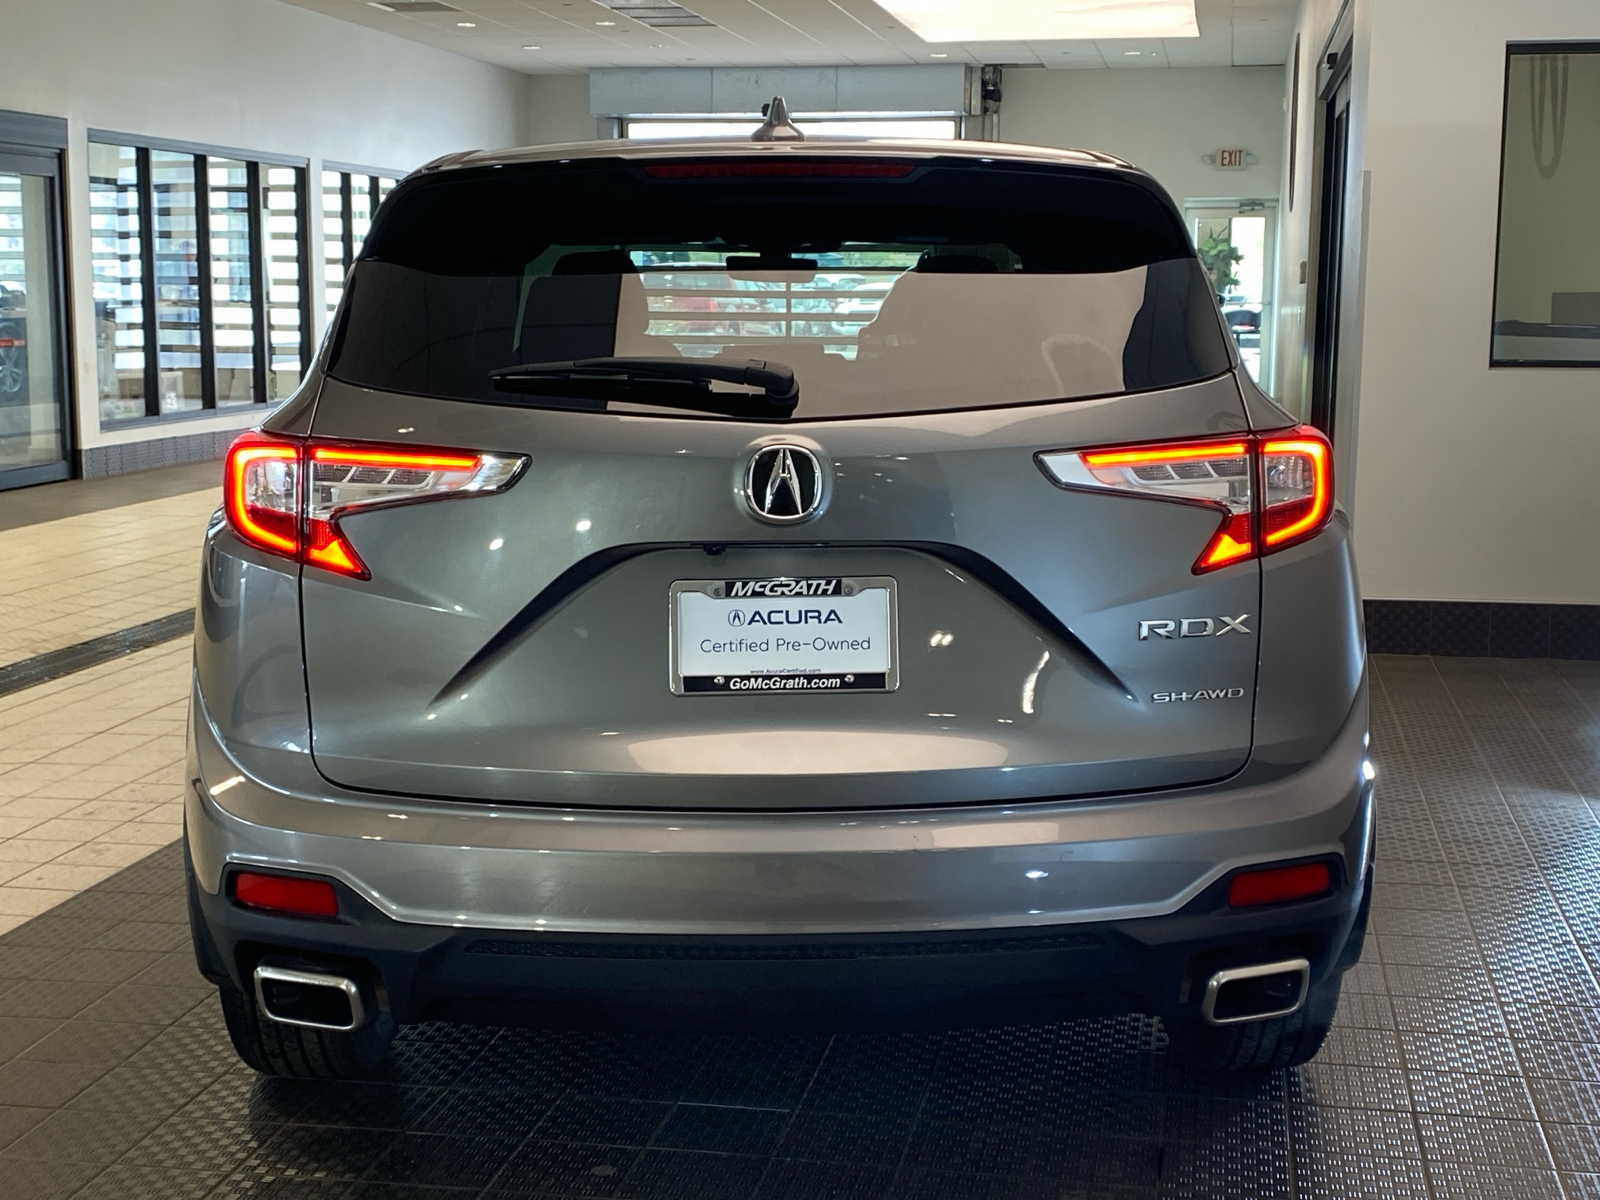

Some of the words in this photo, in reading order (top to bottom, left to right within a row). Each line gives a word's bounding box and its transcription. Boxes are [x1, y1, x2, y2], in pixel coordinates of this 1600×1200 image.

[1221, 150, 1243, 166] EXIT
[747, 609, 843, 626] ACURA
[1138, 613, 1251, 640] RDX
[700, 639, 769, 653] Certified
[776, 636, 871, 652] Pre-Owned
[729, 676, 841, 690] GoMcGrath.com
[1152, 687, 1244, 703] SH-AWD
